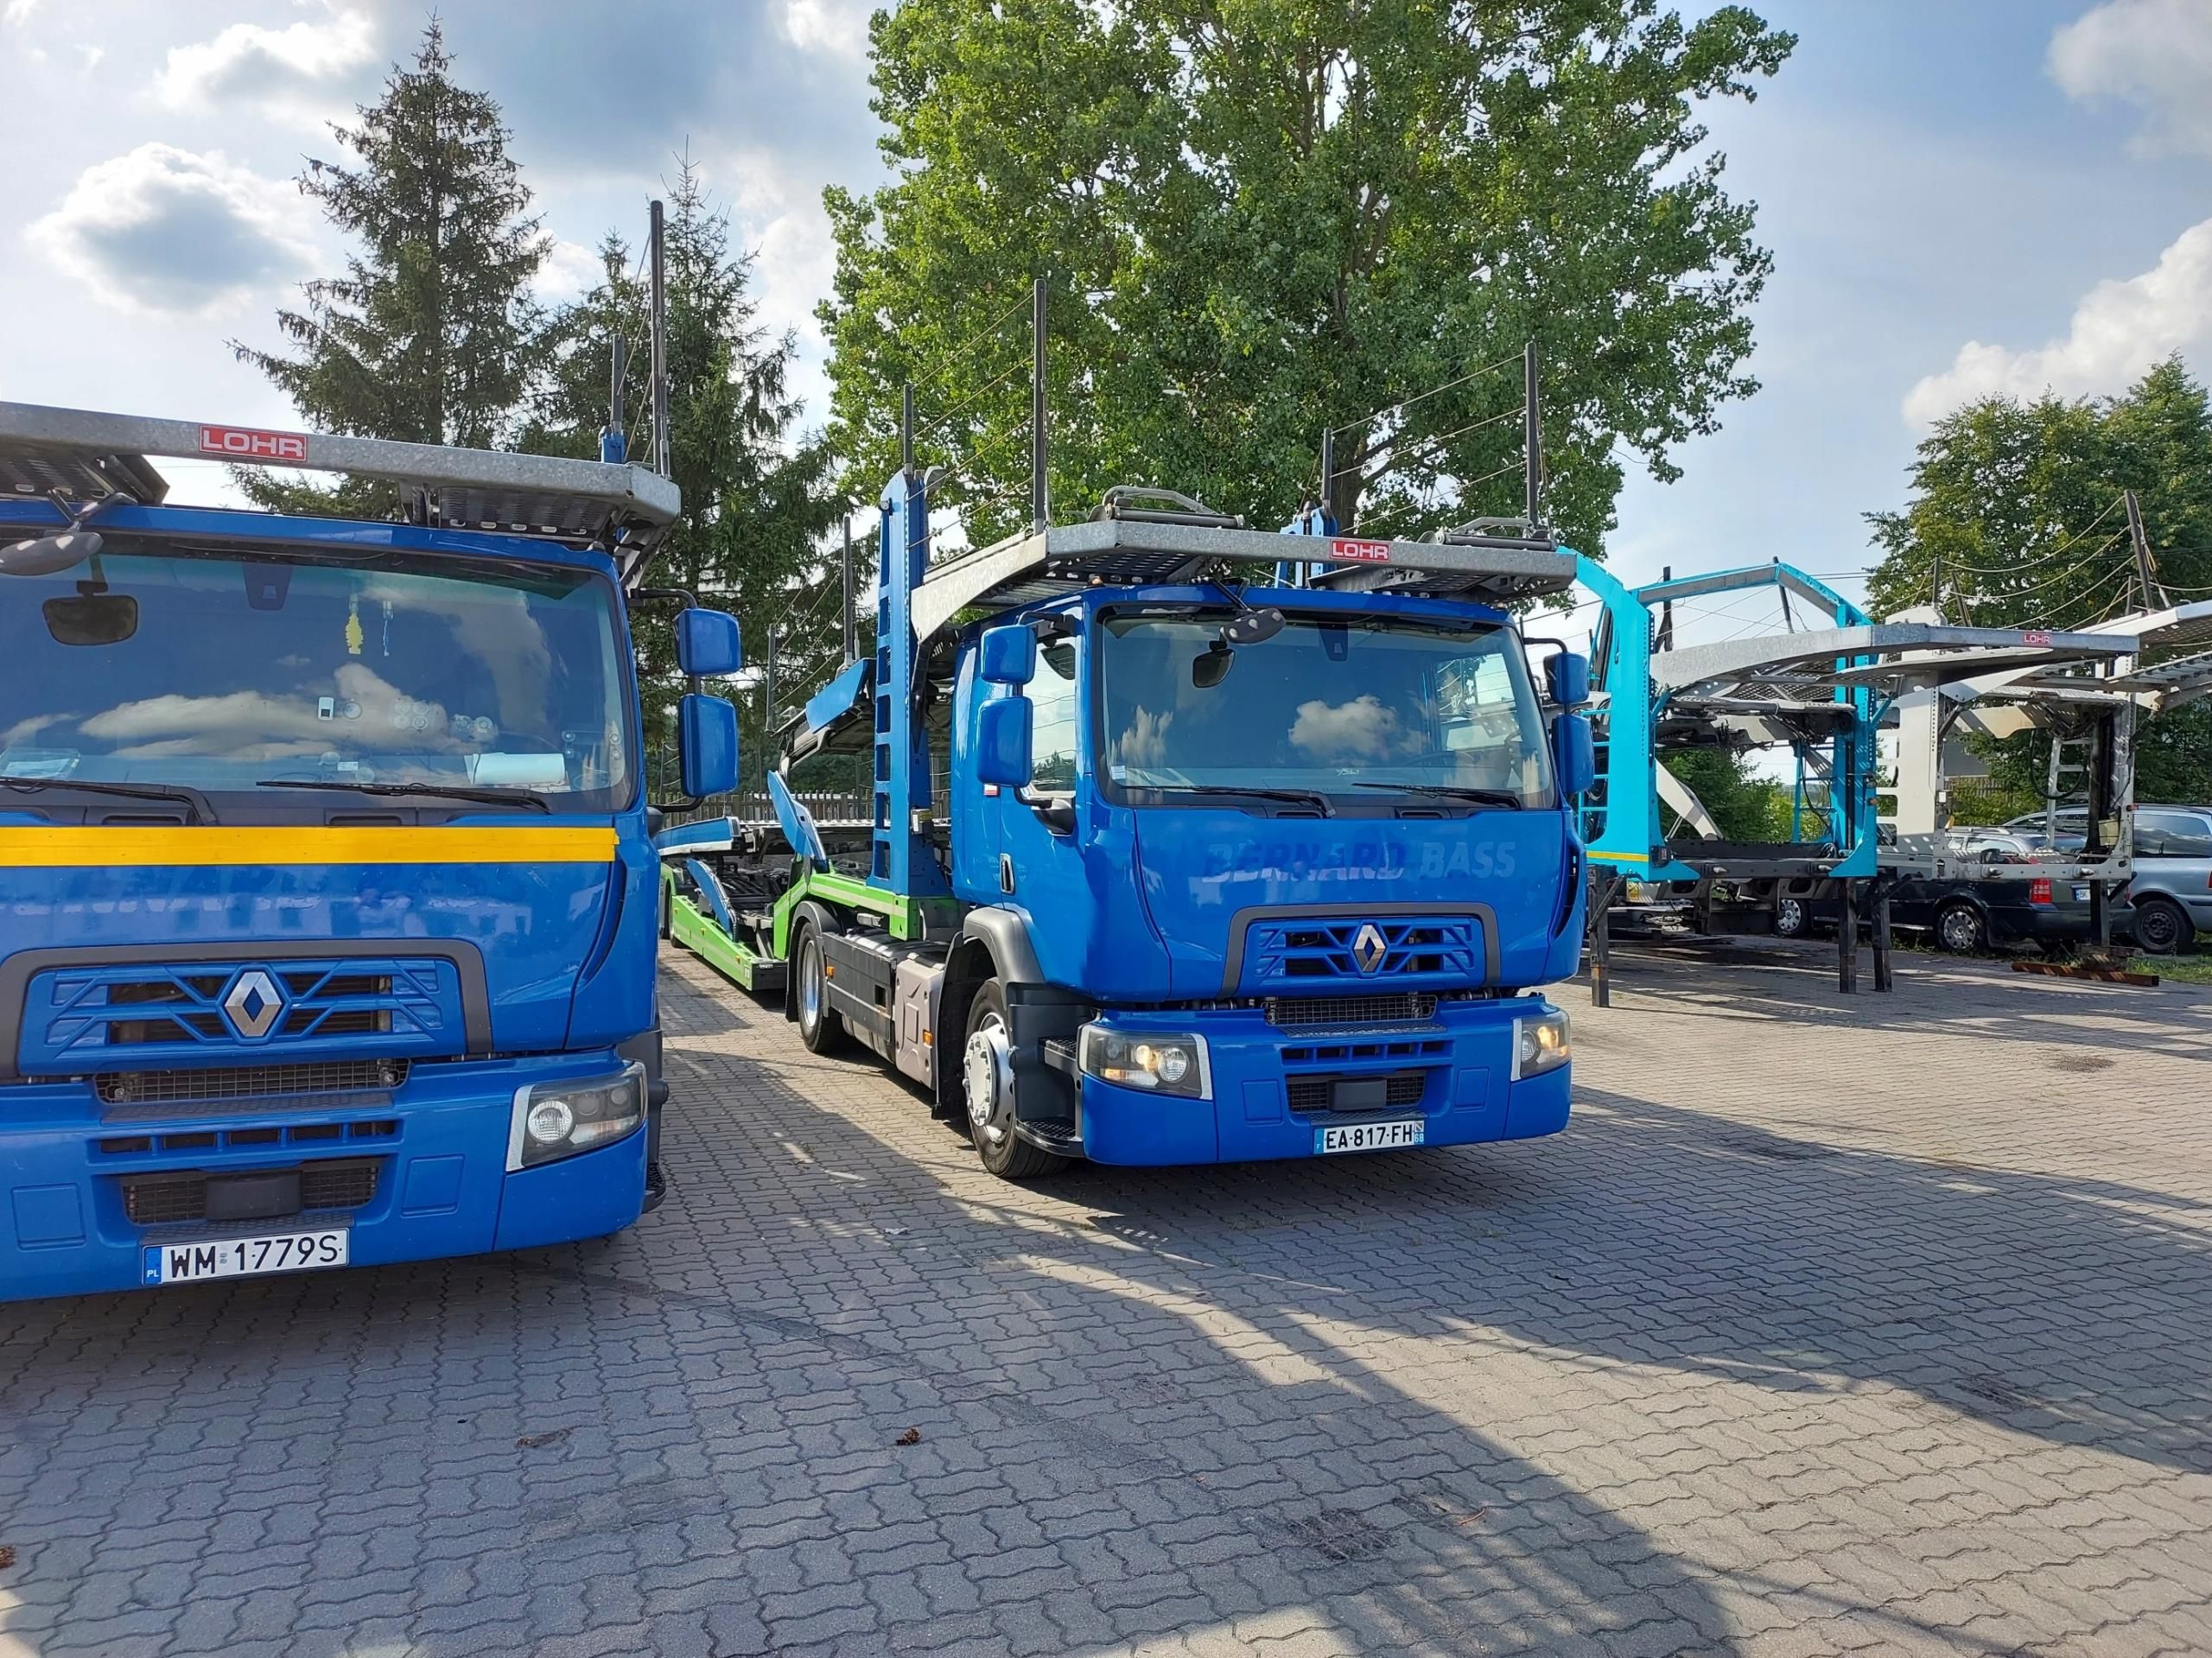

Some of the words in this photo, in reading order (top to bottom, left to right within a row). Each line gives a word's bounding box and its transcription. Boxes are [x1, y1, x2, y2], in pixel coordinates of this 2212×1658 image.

[202, 429, 303, 457] LOHR
[1332, 542, 1389, 560] LOHR
[2024, 634, 2050, 644] LOHR
[1203, 842, 1407, 882] BERNARD
[1419, 842, 1516, 879] BASS
[1414, 1133, 1424, 1143] 68
[146, 1269, 160, 1278] PL
[170, 1245, 216, 1278] WM
[234, 1235, 338, 1271] 1779S
